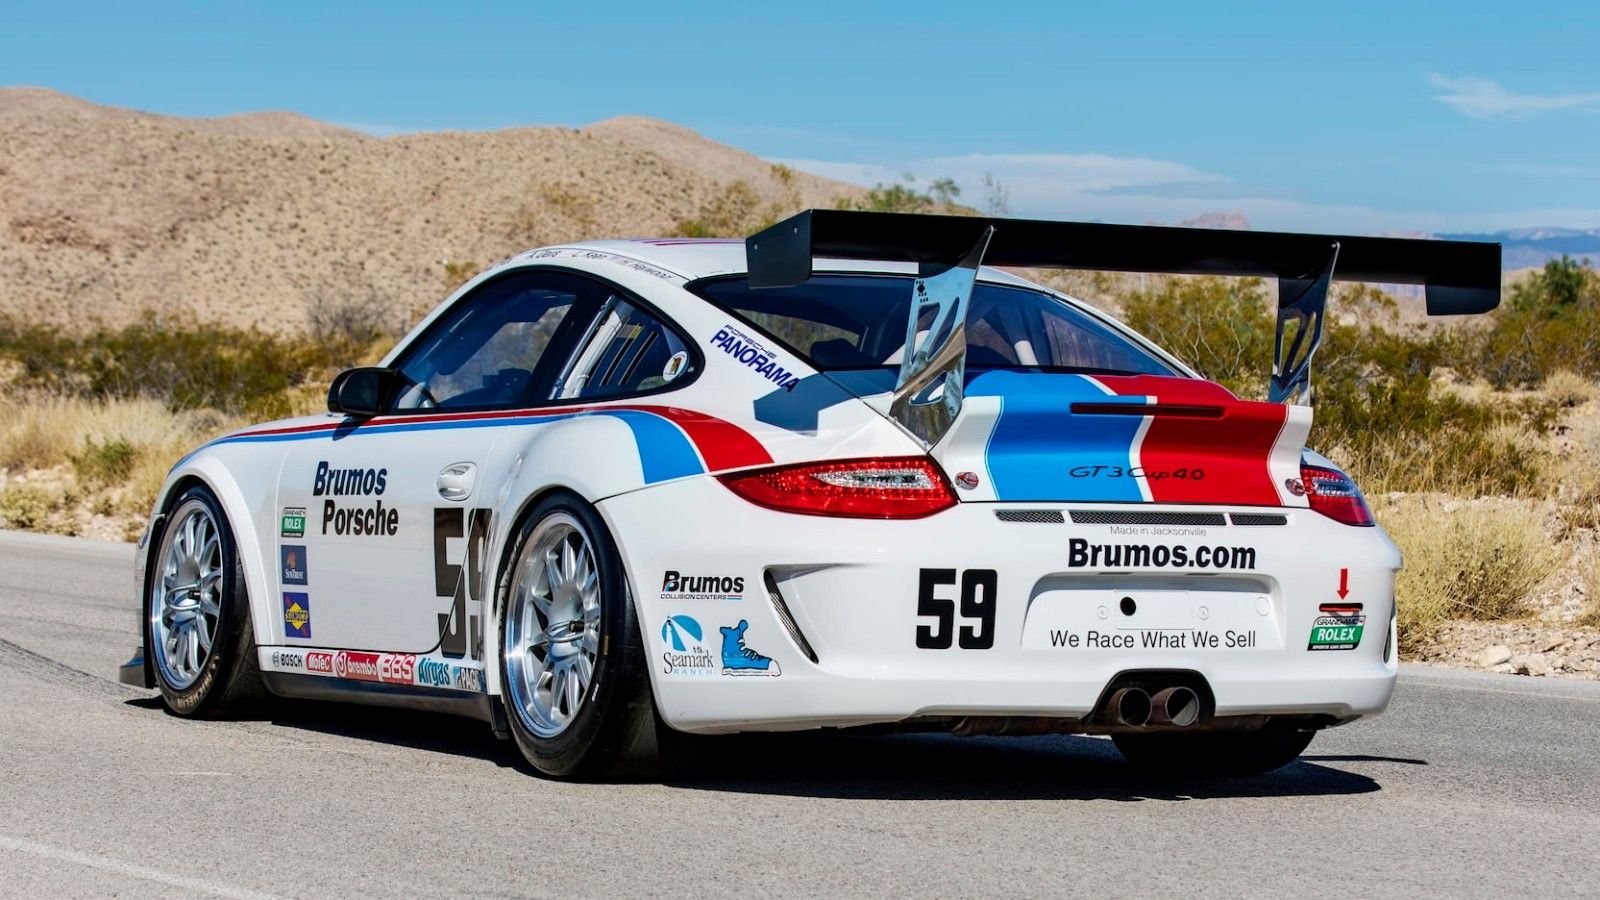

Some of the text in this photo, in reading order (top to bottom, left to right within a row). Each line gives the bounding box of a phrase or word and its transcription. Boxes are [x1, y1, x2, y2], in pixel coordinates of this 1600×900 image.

[710, 329, 800, 393] PANORAMA
[313, 460, 387, 496] Brumos
[322, 499, 399, 536] Porsche
[1110, 526, 1207, 538] Made in Jacksonville
[1068, 537, 1257, 570] Brumos.com
[662, 570, 745, 594] Brumos
[915, 567, 999, 651] 59
[1050, 630, 1257, 648] We Race What We Sell
[1316, 627, 1356, 642] ROLEX
[281, 653, 303, 668] BOSCH
[347, 657, 377, 676] brembo
[381, 654, 415, 680] BBS
[418, 658, 451, 686] Airgas
[663, 650, 714, 674] Seamark
